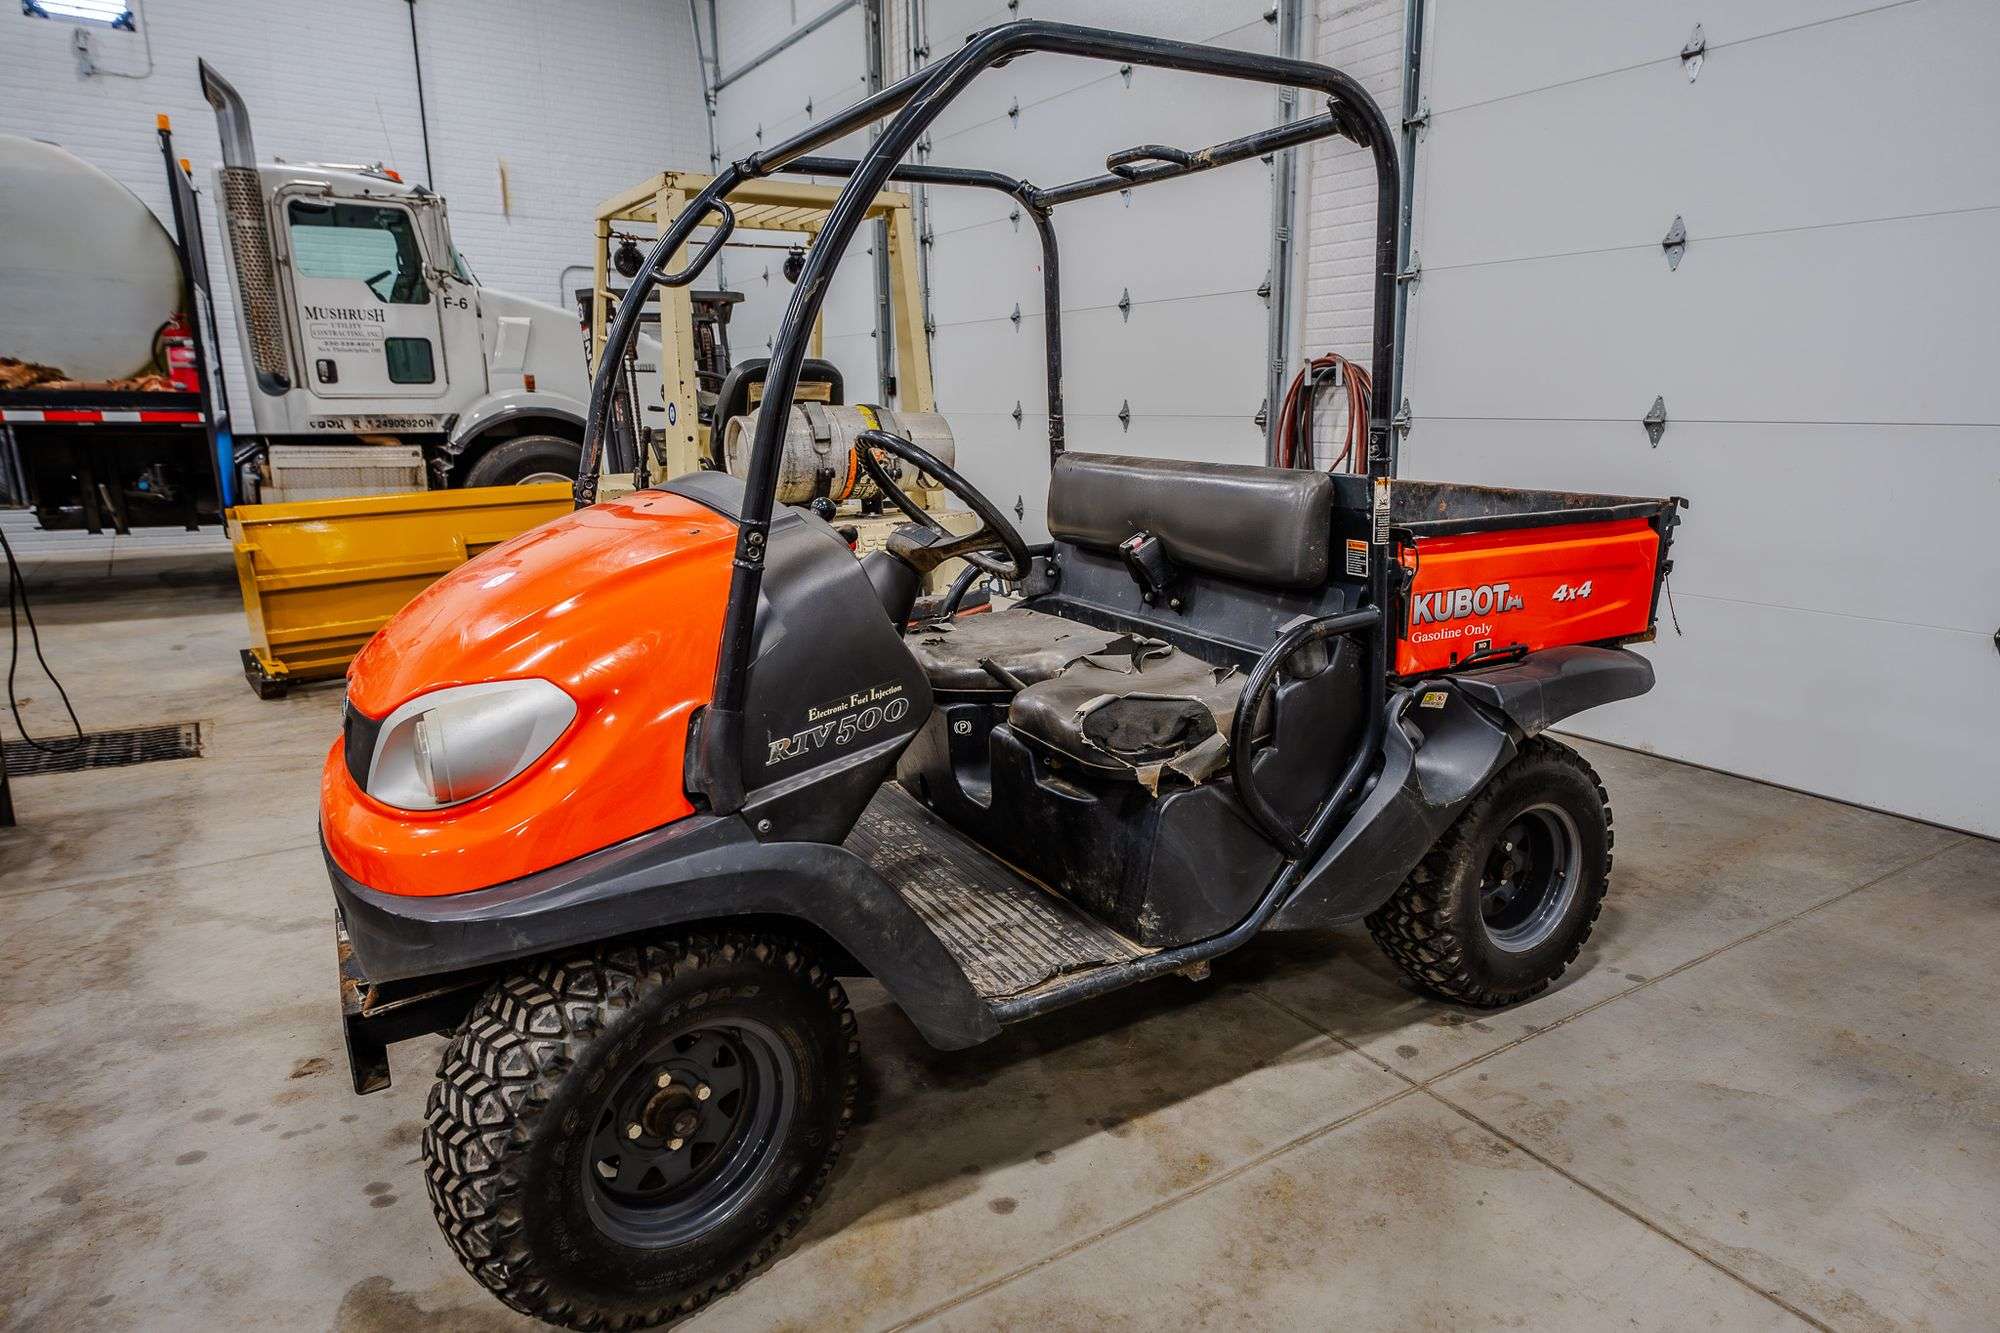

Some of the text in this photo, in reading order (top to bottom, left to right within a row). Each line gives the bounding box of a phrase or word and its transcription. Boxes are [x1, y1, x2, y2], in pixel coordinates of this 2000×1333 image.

[304, 305, 386, 322] MUSHRUSH
[443, 297, 469, 310] F-6
[1552, 580, 1593, 603] 4x4
[1411, 622, 1493, 644] Gasoline Only
[808, 684, 903, 722] Electronic Fuel Injection
[765, 697, 910, 767] RTV500
